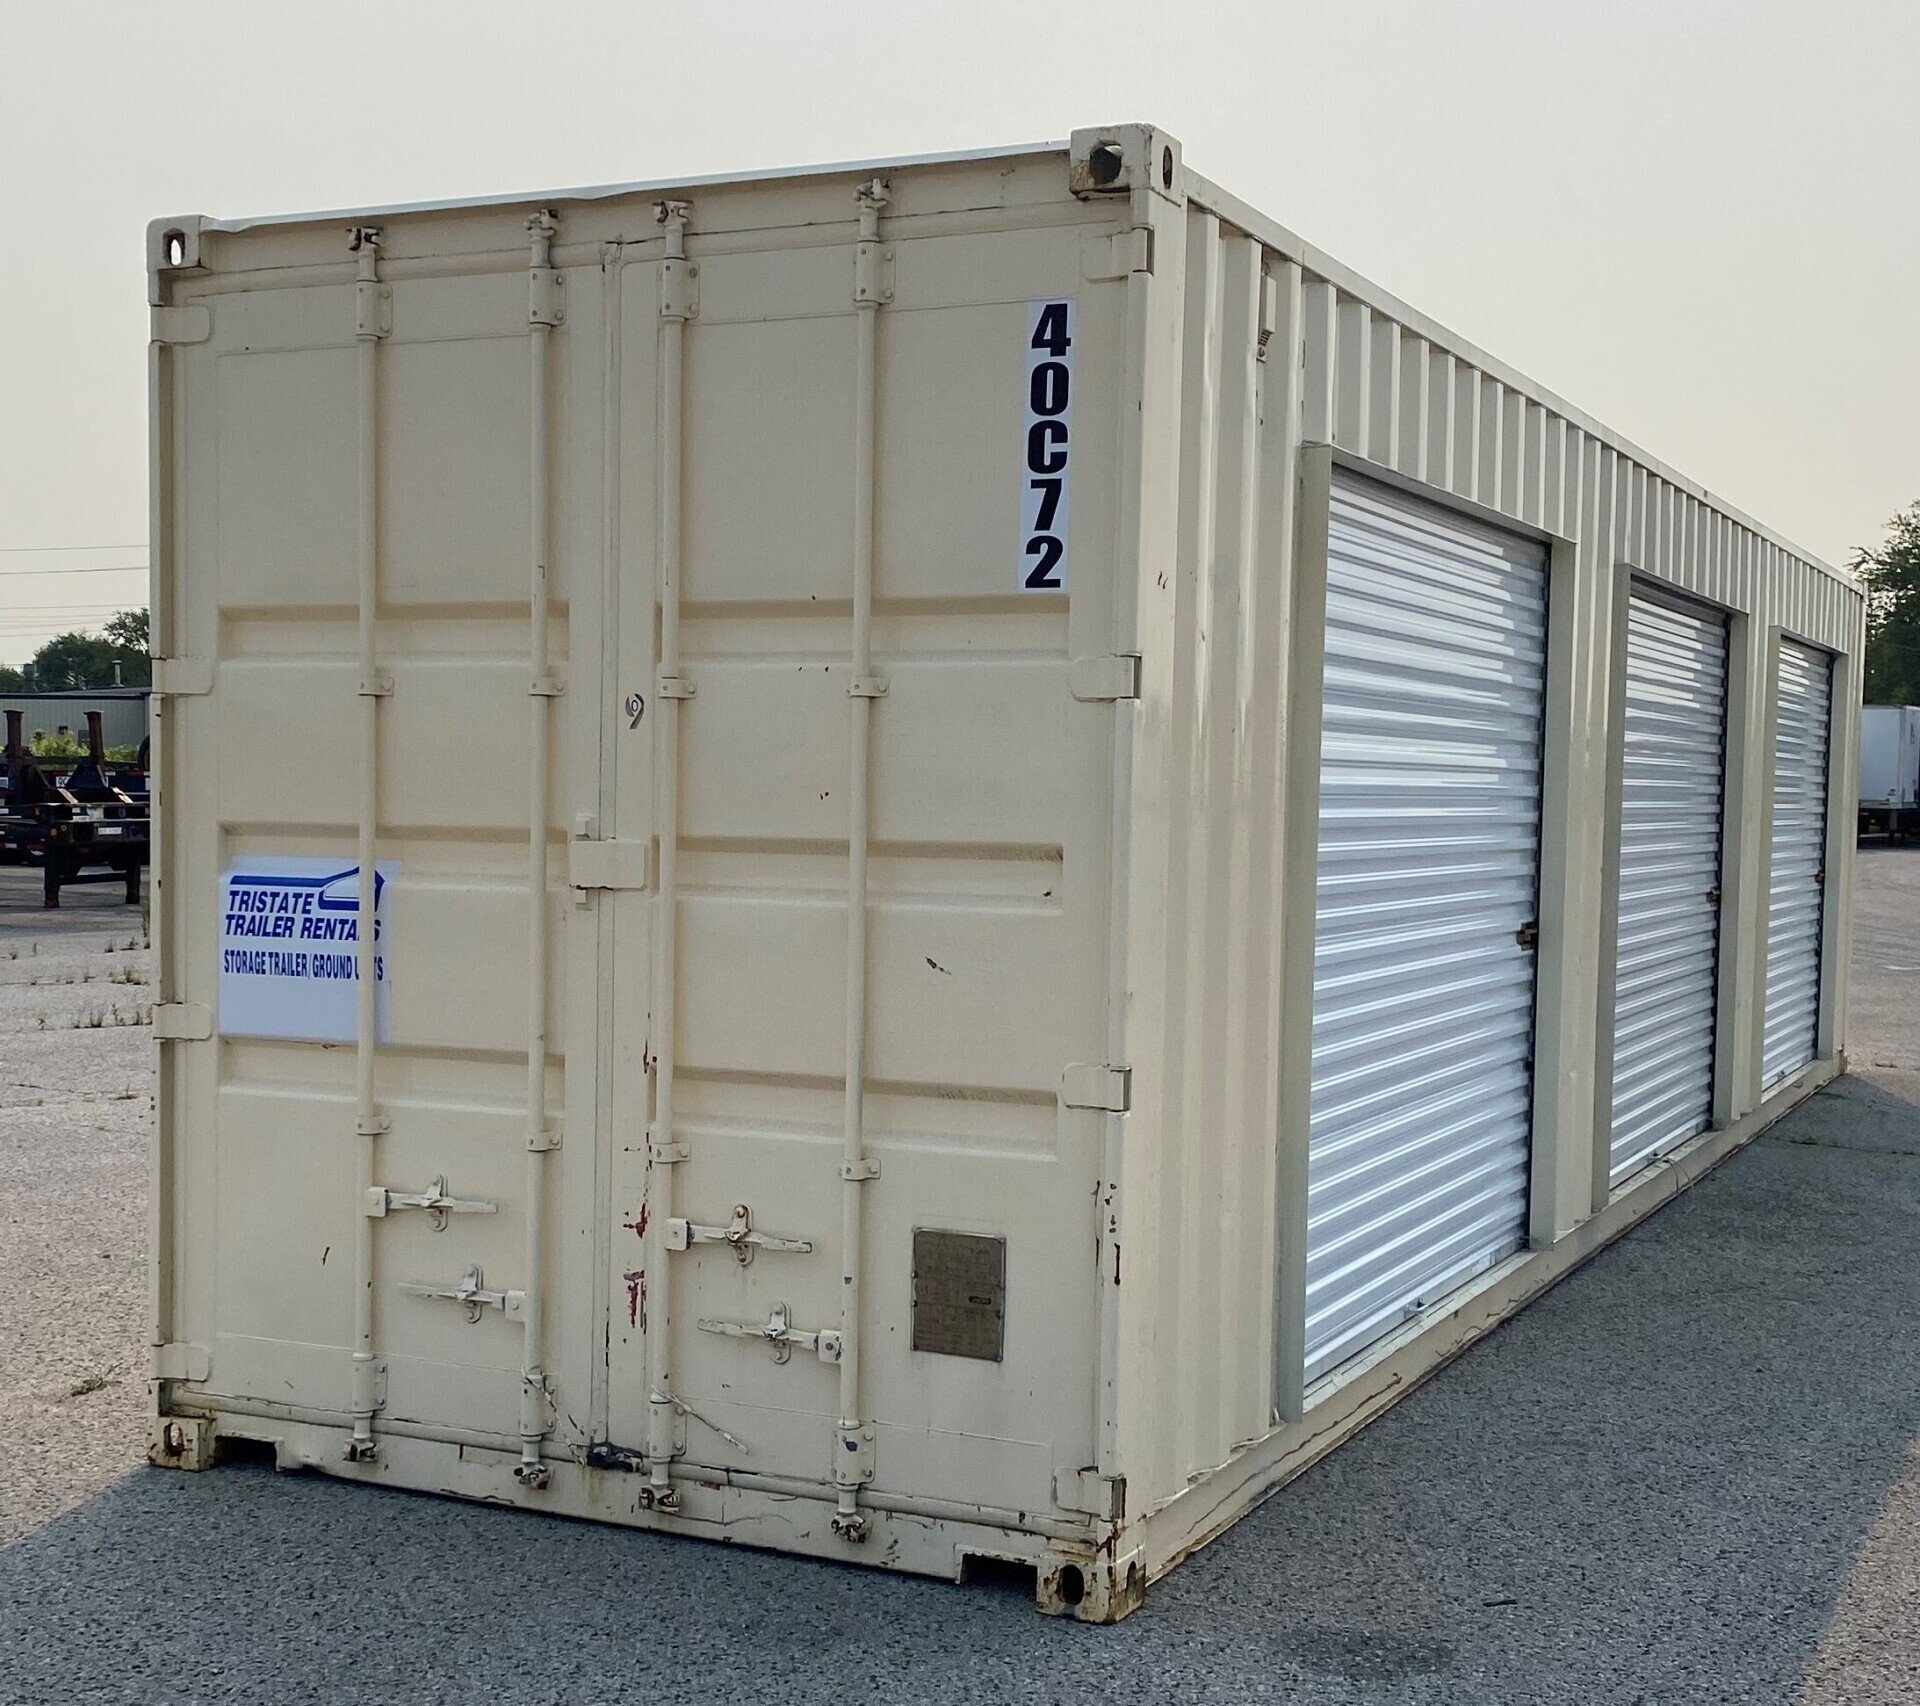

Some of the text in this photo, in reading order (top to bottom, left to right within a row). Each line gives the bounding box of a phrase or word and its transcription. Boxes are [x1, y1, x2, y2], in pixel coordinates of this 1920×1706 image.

[1025, 303, 1071, 589] 40C72
[229, 890, 315, 915] TRISTATE
[225, 914, 382, 941] TRAILER RENTAS
[224, 949, 266, 975] STORAGE
